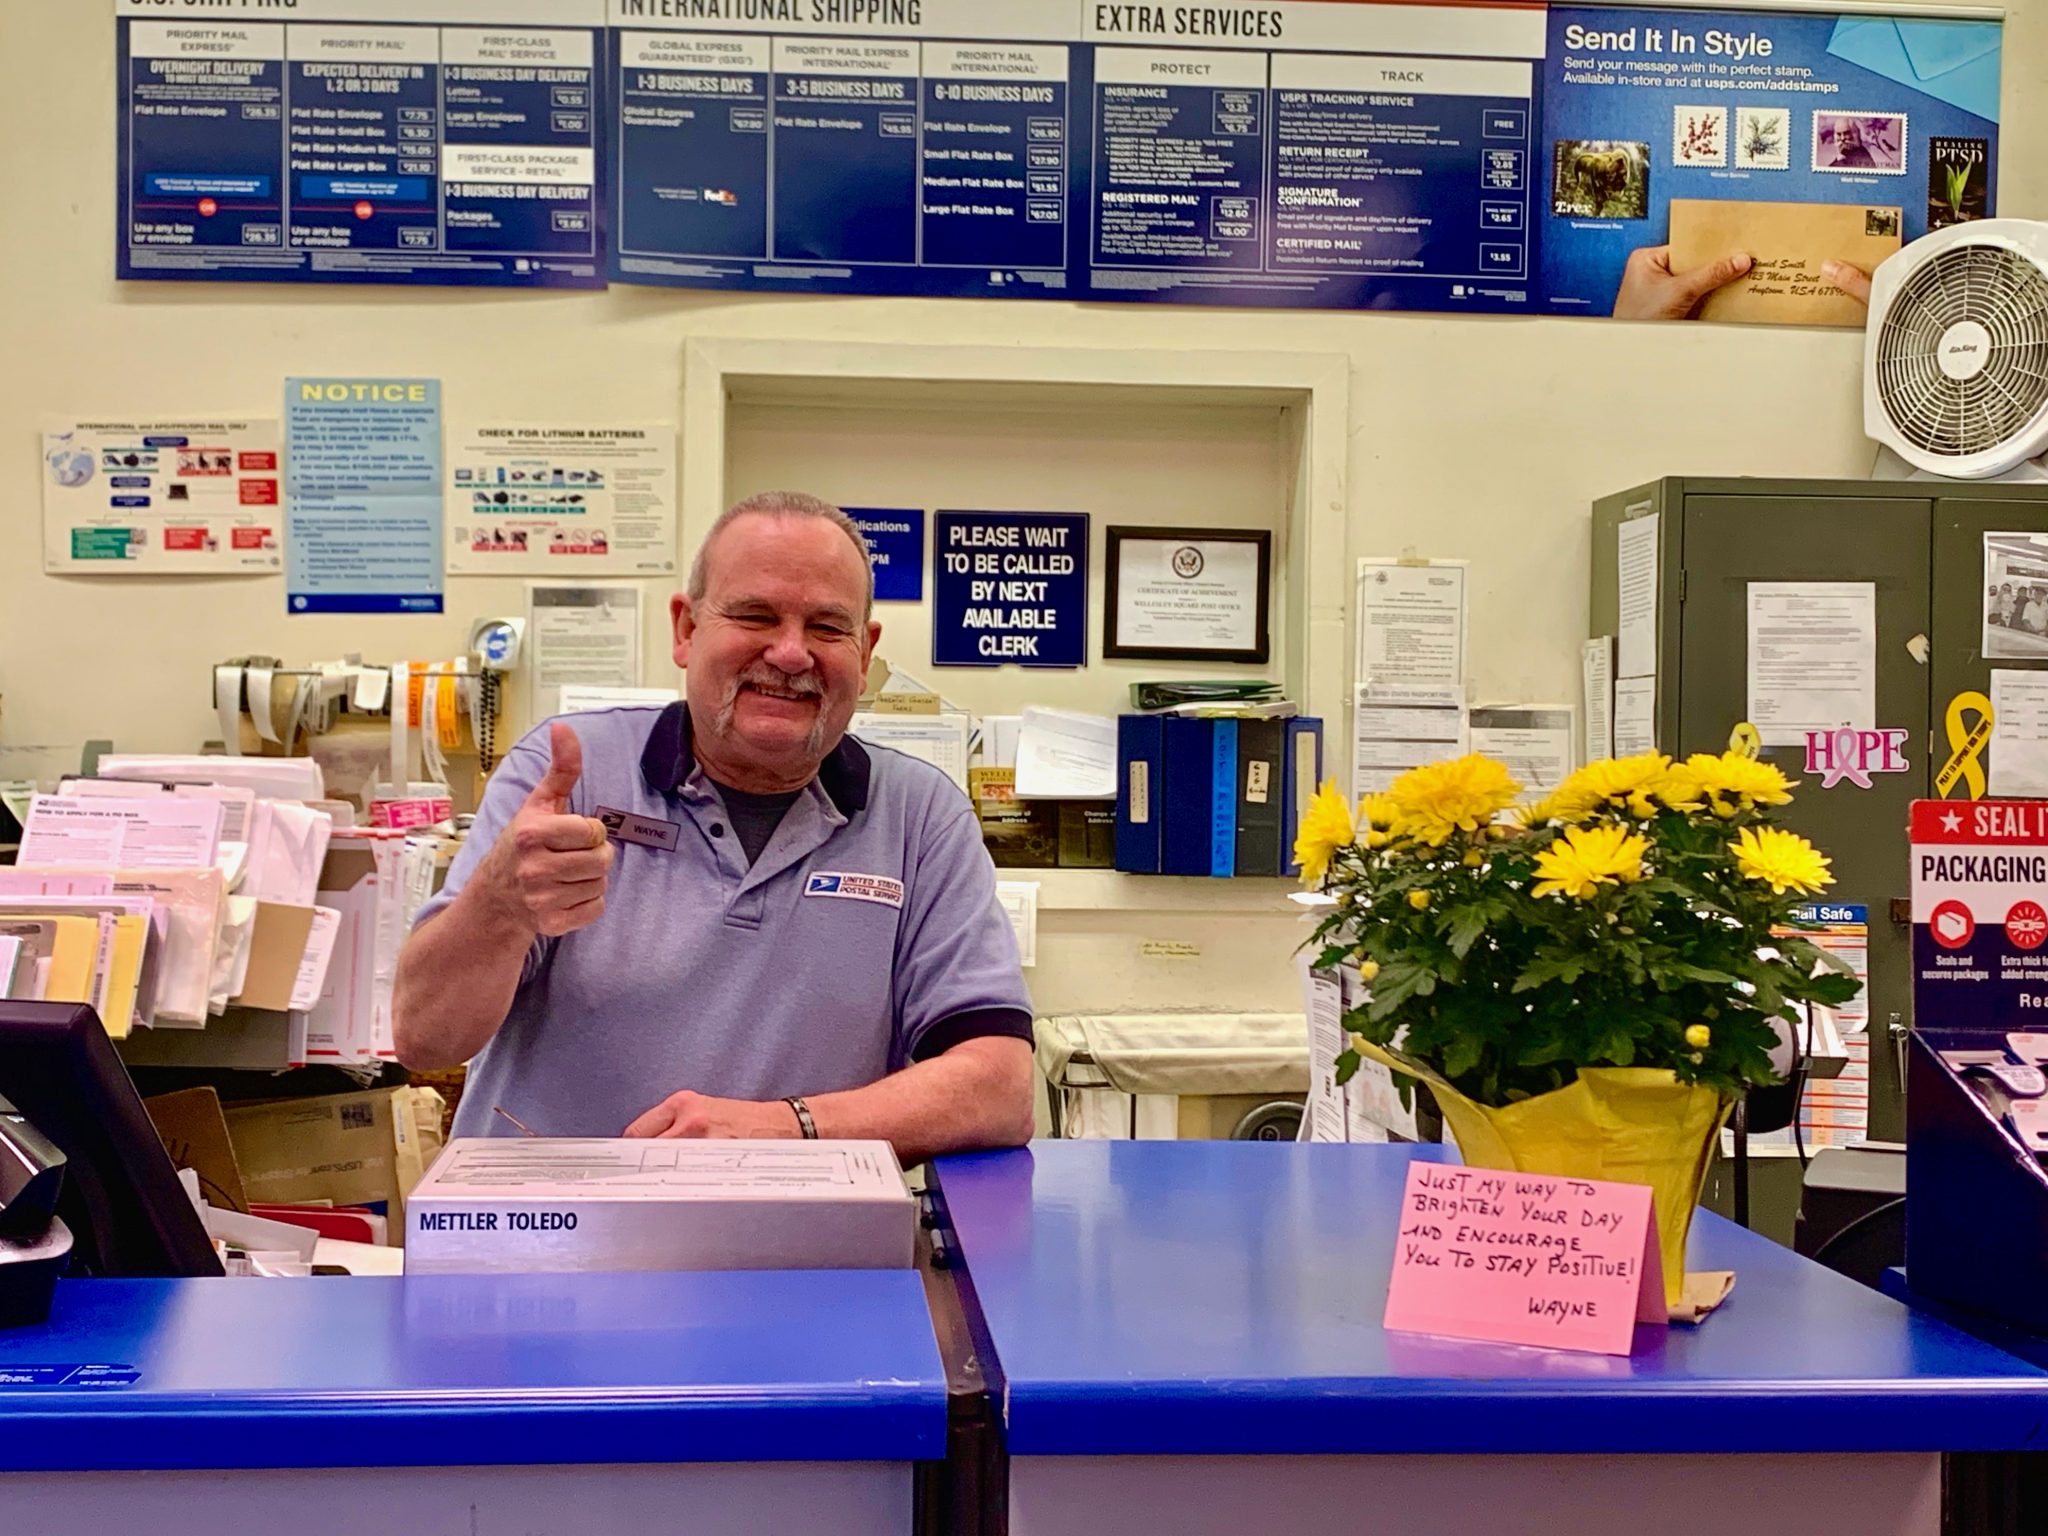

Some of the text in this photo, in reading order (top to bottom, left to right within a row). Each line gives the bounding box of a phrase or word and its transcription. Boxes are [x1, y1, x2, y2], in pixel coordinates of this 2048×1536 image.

[621, 0, 921, 25] INTERNATIONAL SHIPPING
[1096, 5, 1283, 38] EXTRA SERVICES
[166, 30, 248, 41] PRIORITY MAIL
[321, 40, 372, 49] PRIORITY
[483, 37, 551, 47] FIRST-CLASS
[649, 41, 743, 52] GLOBAL EXPRESS
[1565, 25, 1773, 60] Send It In Style
[510, 50, 556, 59] SERVICE
[785, 45, 909, 58] PRIORITY MAIL EXPRESS
[956, 51, 1034, 61] PRIORITY MAIL
[150, 61, 265, 75] OVERNIGHT DELIVERY
[303, 64, 424, 79] EXPECTED DELIVERY IN
[1151, 63, 1211, 75] PROTECT
[1564, 57, 1814, 78] Send your message with the perfect stamp.
[1381, 71, 1424, 83] TRACK
[1563, 72, 1839, 94] Available in-store and at usps.com/addstamps
[638, 74, 753, 93] 1-3 BUSINESS DAYS
[786, 79, 904, 98] 3-5 BUSINESS DAYS
[935, 84, 1053, 103] 6-10 BUSINESS DAYS
[1105, 87, 1168, 99] INSURANCE
[1280, 93, 1308, 103] USPS
[1369, 96, 1414, 107] SERVICE
[1494, 120, 1514, 128] FREE
[1935, 141, 1983, 149] HEALING
[923, 149, 950, 159] Small
[951, 150, 970, 160] Flat
[971, 151, 993, 160] Rate
[994, 151, 1014, 161] Box
[1279, 146, 1369, 158] RETURN RECEIPT
[1935, 148, 1983, 163] PTSD
[457, 154, 579, 164] FIRST-CLASS PACKAGE
[923, 177, 961, 187] Medium
[962, 178, 981, 188] Flat
[982, 179, 1004, 188] Rate
[1006, 179, 1025, 189] Box
[1102, 192, 1169, 204] REGISTERED
[1278, 187, 1338, 197] SIGNATURE
[923, 204, 950, 215] Large
[952, 204, 971, 214] Flat
[972, 205, 994, 215] Rate
[995, 206, 1015, 216] Box
[1555, 201, 1592, 213] T.rex
[1276, 238, 1332, 249] CERTIFIED
[1781, 257, 1806, 269] Smith
[1747, 271, 1820, 283] 123 Main Street
[1790, 285, 1817, 296] USA
[301, 383, 426, 401] NOTICE
[478, 429, 645, 439] CHECK FOR LITHIUM BATTERIES
[950, 526, 1069, 548] PLEASE WAIT
[944, 553, 1074, 575] TO BE CALLED
[971, 581, 1048, 602] BY NEXT
[963, 608, 1056, 629] AVAILABLE
[979, 635, 1038, 656] CLERK
[1804, 728, 1908, 775] HOPE
[1938, 771, 1951, 785] PRAY
[1953, 745, 1971, 767] SUPPORT
[998, 810, 1022, 819] Change
[1084, 810, 1108, 818] Change
[1975, 806, 2030, 837] SEAL
[634, 825, 667, 840] WAYNE
[1921, 855, 2046, 883] PACKAGING
[843, 876, 874, 886] UNITED
[840, 886, 871, 896] POSTAL
[1798, 907, 1853, 920] ail Safe
[1936, 955, 1973, 966] Seals and
[2001, 955, 2040, 966] Extra thick
[1922, 970, 1989, 981] secures packages
[2001, 969, 2024, 980] added
[1418, 1169, 1596, 1202] JUST MY WAY TO
[1412, 1194, 1623, 1234] BRIGHTEN YOUR DAY
[419, 1212, 577, 1231] METTLER TOLEDO
[1402, 1225, 1582, 1257] AND ENCOURAGE
[1404, 1244, 1635, 1284] YOU TO STAY POSITIVE!
[1528, 1297, 1598, 1325] WAYNE
